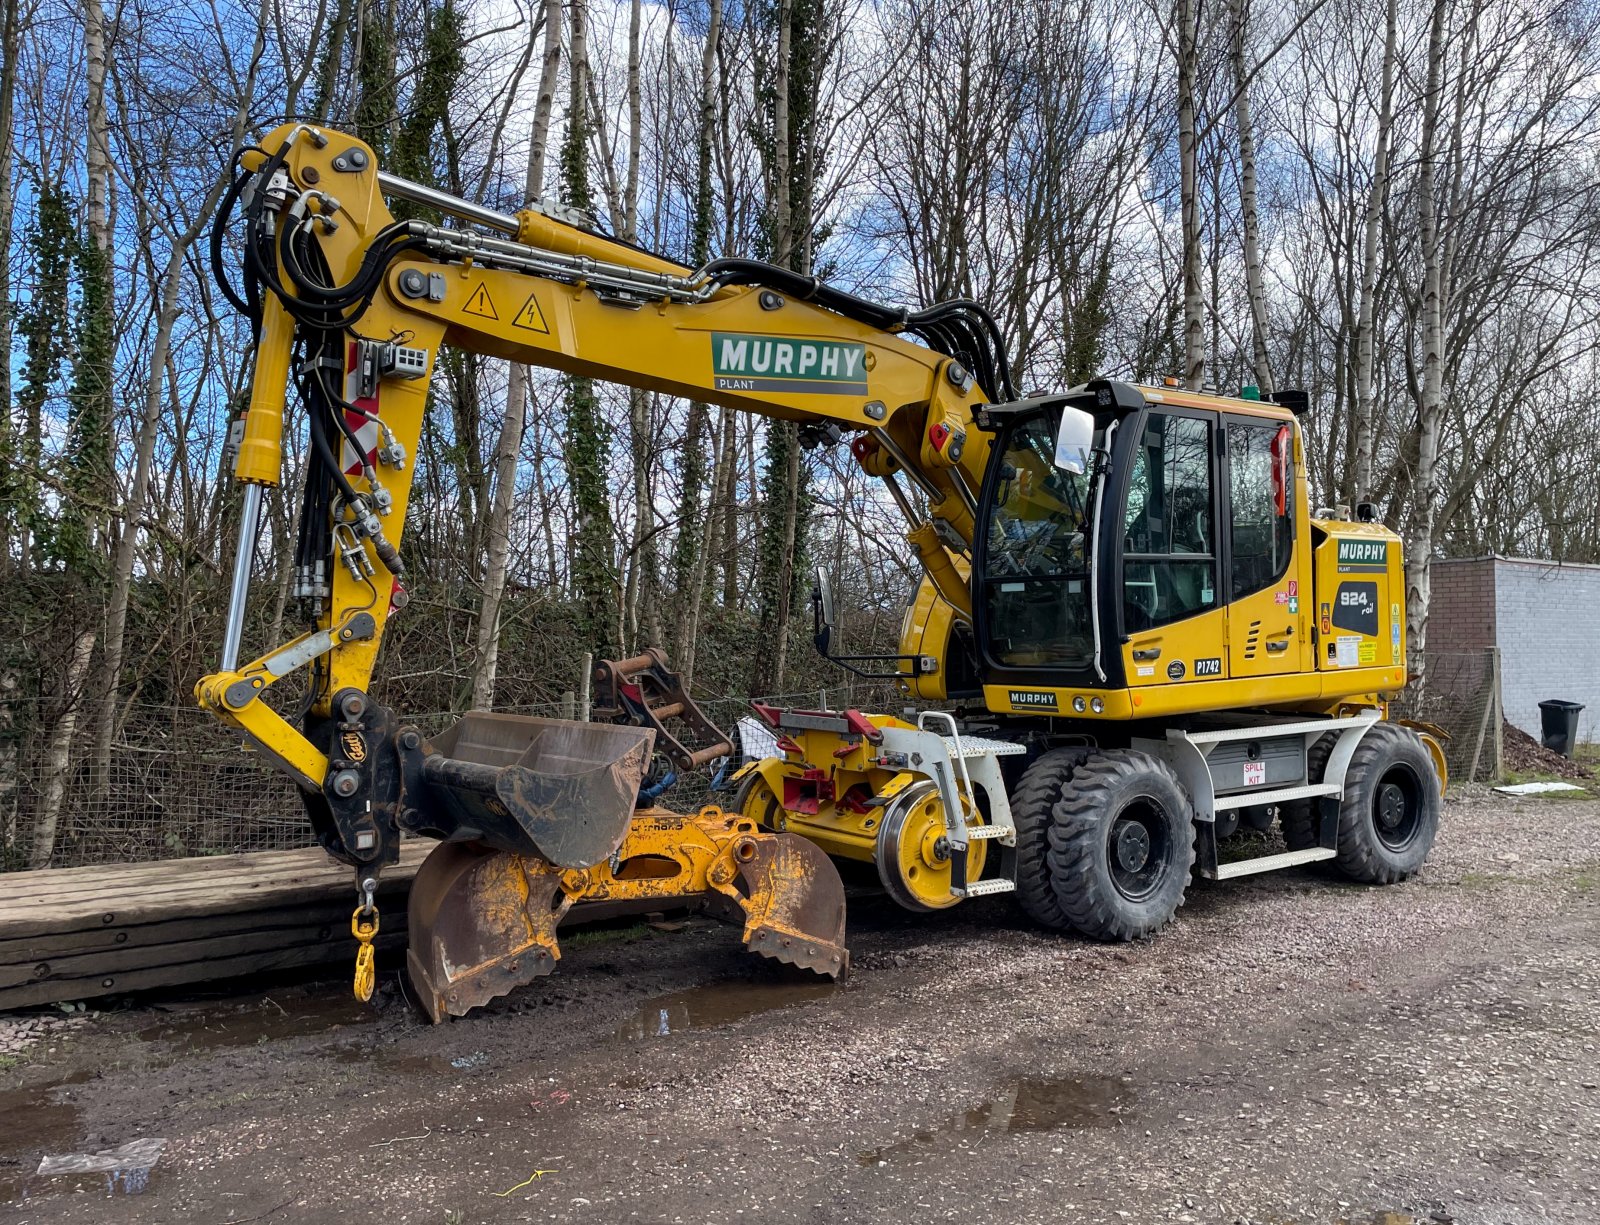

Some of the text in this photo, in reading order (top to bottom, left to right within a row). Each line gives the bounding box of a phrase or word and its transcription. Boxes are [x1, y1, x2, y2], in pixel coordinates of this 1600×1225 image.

[719, 338, 861, 377] MURPHY
[720, 378, 754, 389] PLANT
[1340, 543, 1385, 560] MURPHY
[1341, 592, 1368, 606] 924
[1362, 602, 1374, 615] rail
[1197, 660, 1219, 674] P1742
[1011, 693, 1054, 704] MURPHY
[1245, 762, 1264, 772] SPILL
[1249, 775, 1260, 785] KIT
